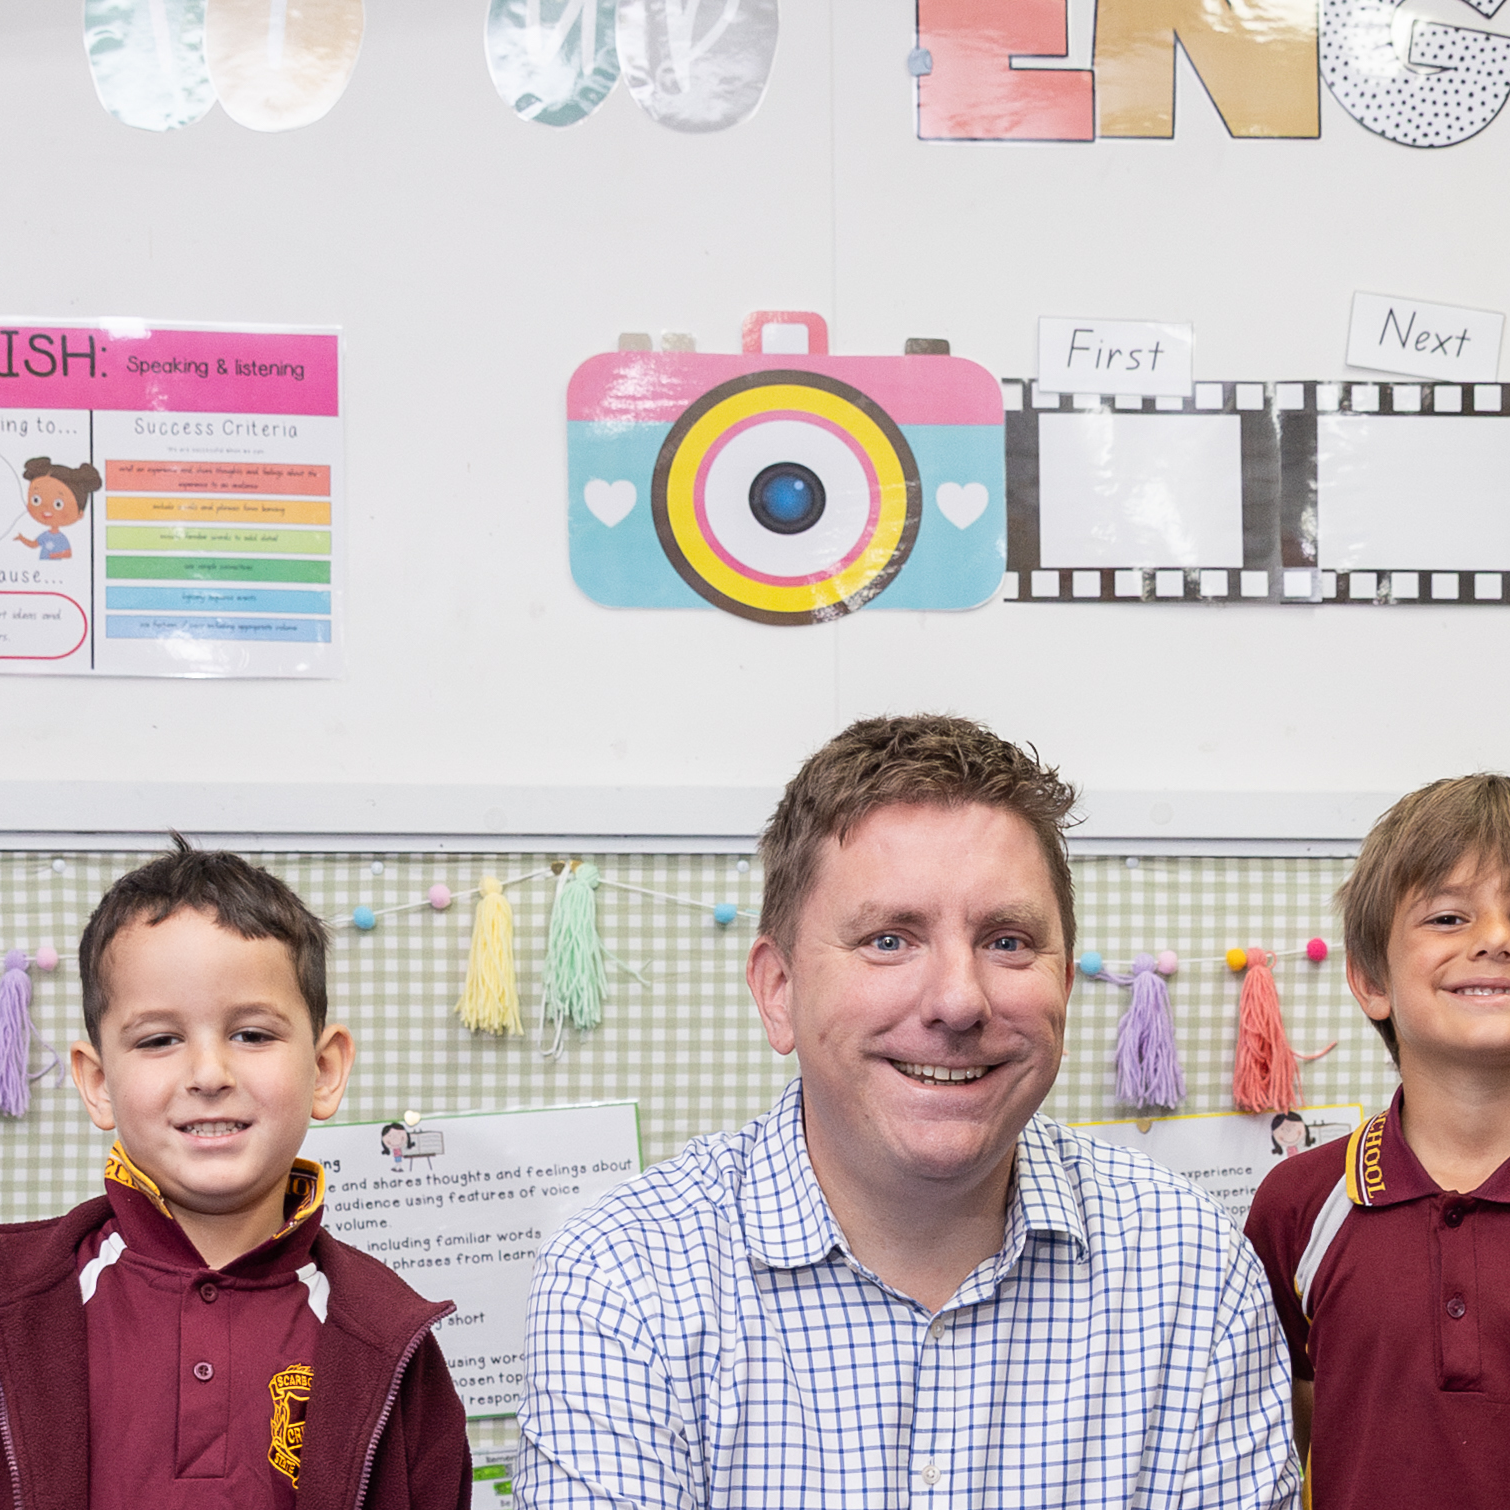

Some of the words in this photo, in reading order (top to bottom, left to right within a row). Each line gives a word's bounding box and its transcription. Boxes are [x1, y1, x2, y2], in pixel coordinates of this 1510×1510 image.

[1378, 308, 1471, 360] Next
[1066, 329, 1165, 371] First
[126, 356, 209, 379] Speaking
[216, 358, 228, 375] &
[235, 358, 305, 381] listening
[135, 418, 214, 436] Success
[222, 420, 298, 438] Criteria
[342, 1179, 366, 1192] and
[373, 1177, 421, 1190] shares
[426, 1170, 490, 1187] thoughts
[496, 1166, 520, 1180] and
[527, 1163, 586, 1178] feelings
[592, 1159, 632, 1173] about
[335, 1197, 400, 1212] audience
[406, 1194, 442, 1208] using
[449, 1188, 514, 1204] features
[520, 1185, 536, 1198] of
[542, 1184, 579, 1196] voice
[367, 1236, 430, 1252] including
[436, 1231, 492, 1247] familiar
[497, 1228, 541, 1242] words
[393, 1256, 451, 1271] phrases
[457, 1251, 494, 1265] from
[448, 1312, 484, 1326] short
